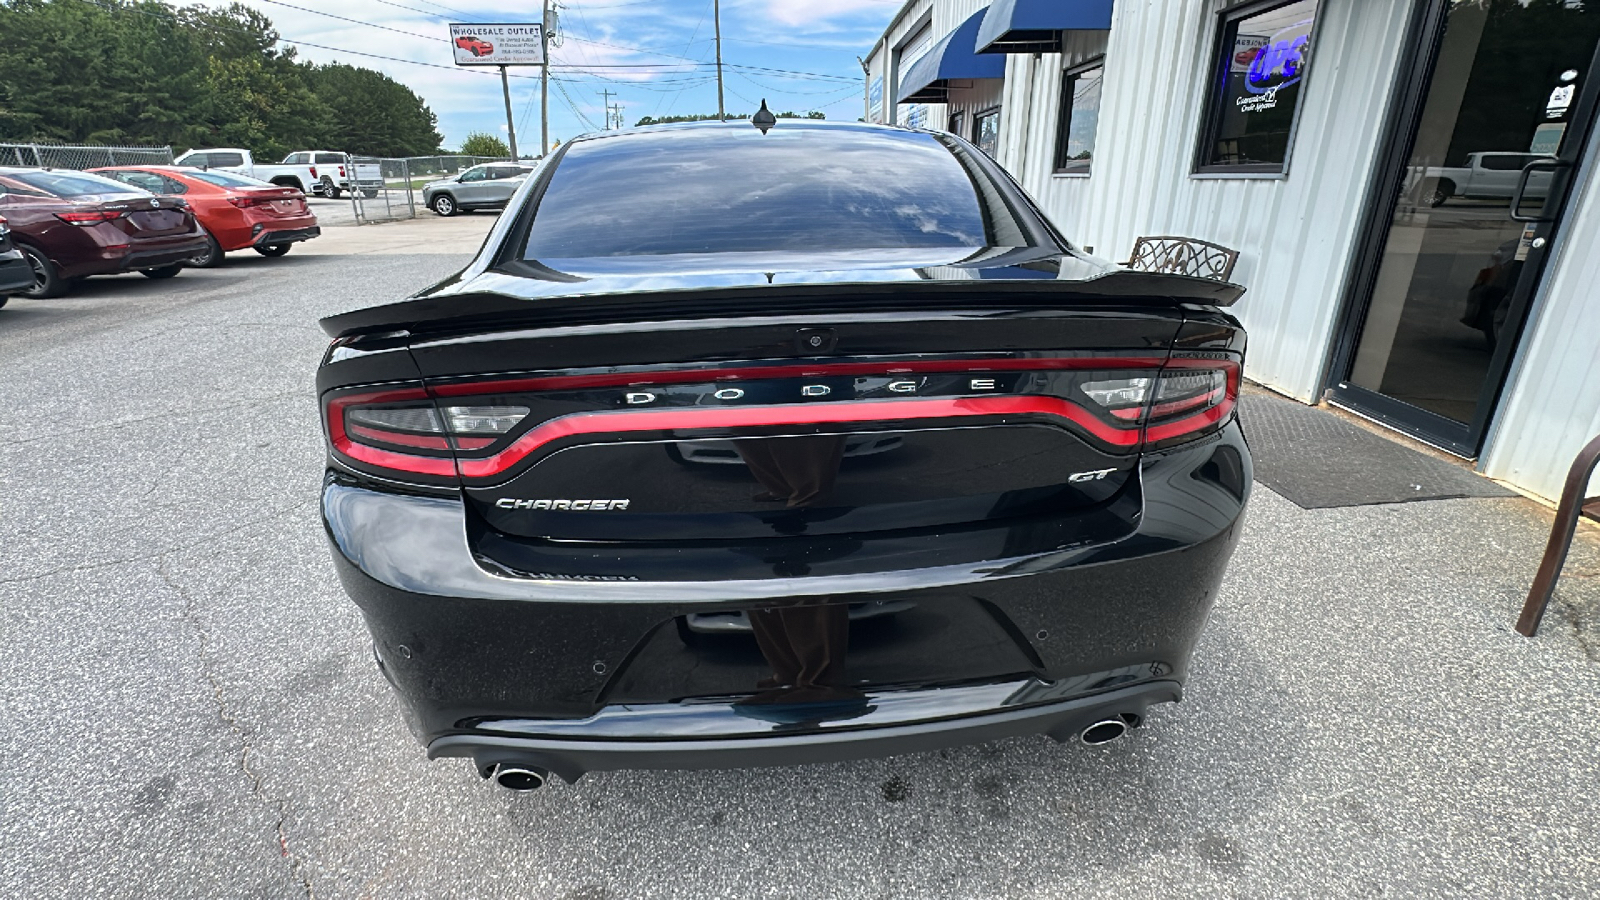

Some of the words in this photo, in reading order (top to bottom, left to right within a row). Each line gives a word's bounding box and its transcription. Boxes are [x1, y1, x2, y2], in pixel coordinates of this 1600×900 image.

[453, 28, 504, 36] WHOLESALE
[625, 378, 995, 404] DODGE
[1068, 467, 1117, 482] GT
[495, 498, 631, 511] CHARGER
